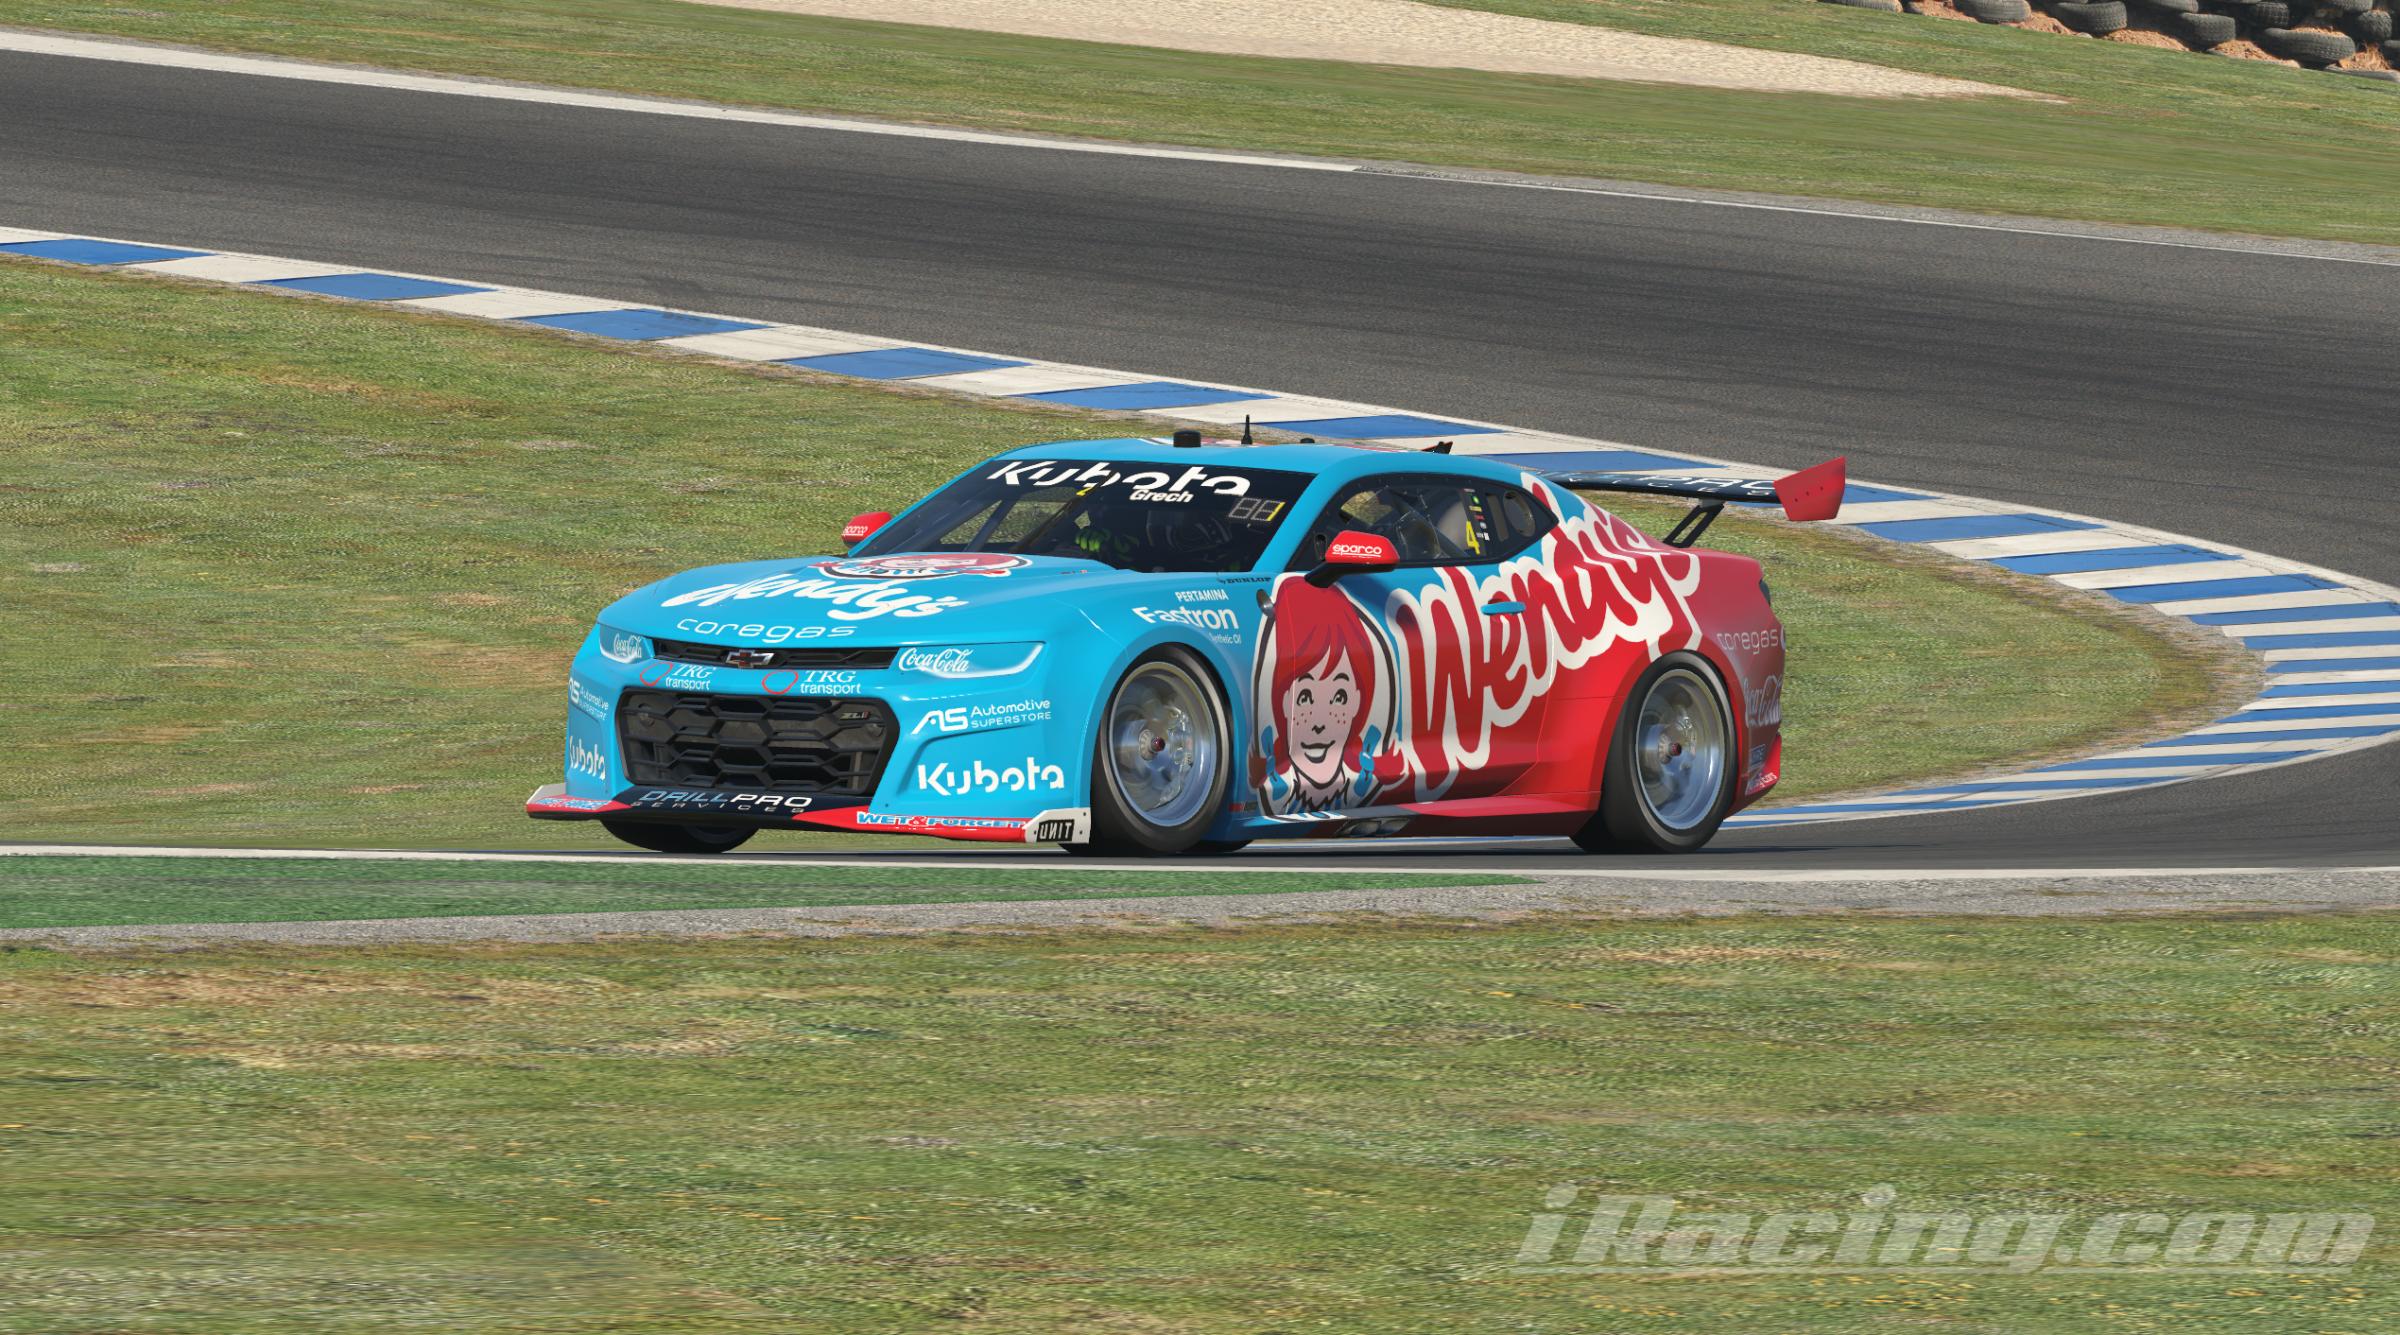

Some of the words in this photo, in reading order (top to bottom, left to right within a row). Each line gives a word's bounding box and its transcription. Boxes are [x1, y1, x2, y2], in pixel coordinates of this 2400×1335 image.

[986, 460, 1252, 497] Kubota
[1129, 489, 1195, 503] Grech
[1465, 521, 1480, 555] 4
[1332, 543, 1383, 556] sparco
[661, 573, 970, 621] Wendy's
[1174, 588, 1229, 603] PERTAMINA
[1131, 605, 1239, 630] Fastron
[676, 618, 858, 644] coregas
[1388, 474, 1701, 802] Wendy's
[1716, 628, 1779, 655] coregas
[672, 663, 715, 679] TRG
[804, 670, 856, 683] TRG
[665, 676, 711, 690] transport
[800, 683, 862, 695] transport
[911, 707, 969, 735] AS
[970, 699, 1050, 718] Automotive
[970, 711, 1052, 729] SUPERSTORE
[917, 756, 1065, 796] Kubota
[630, 801, 804, 813] SERVICES
